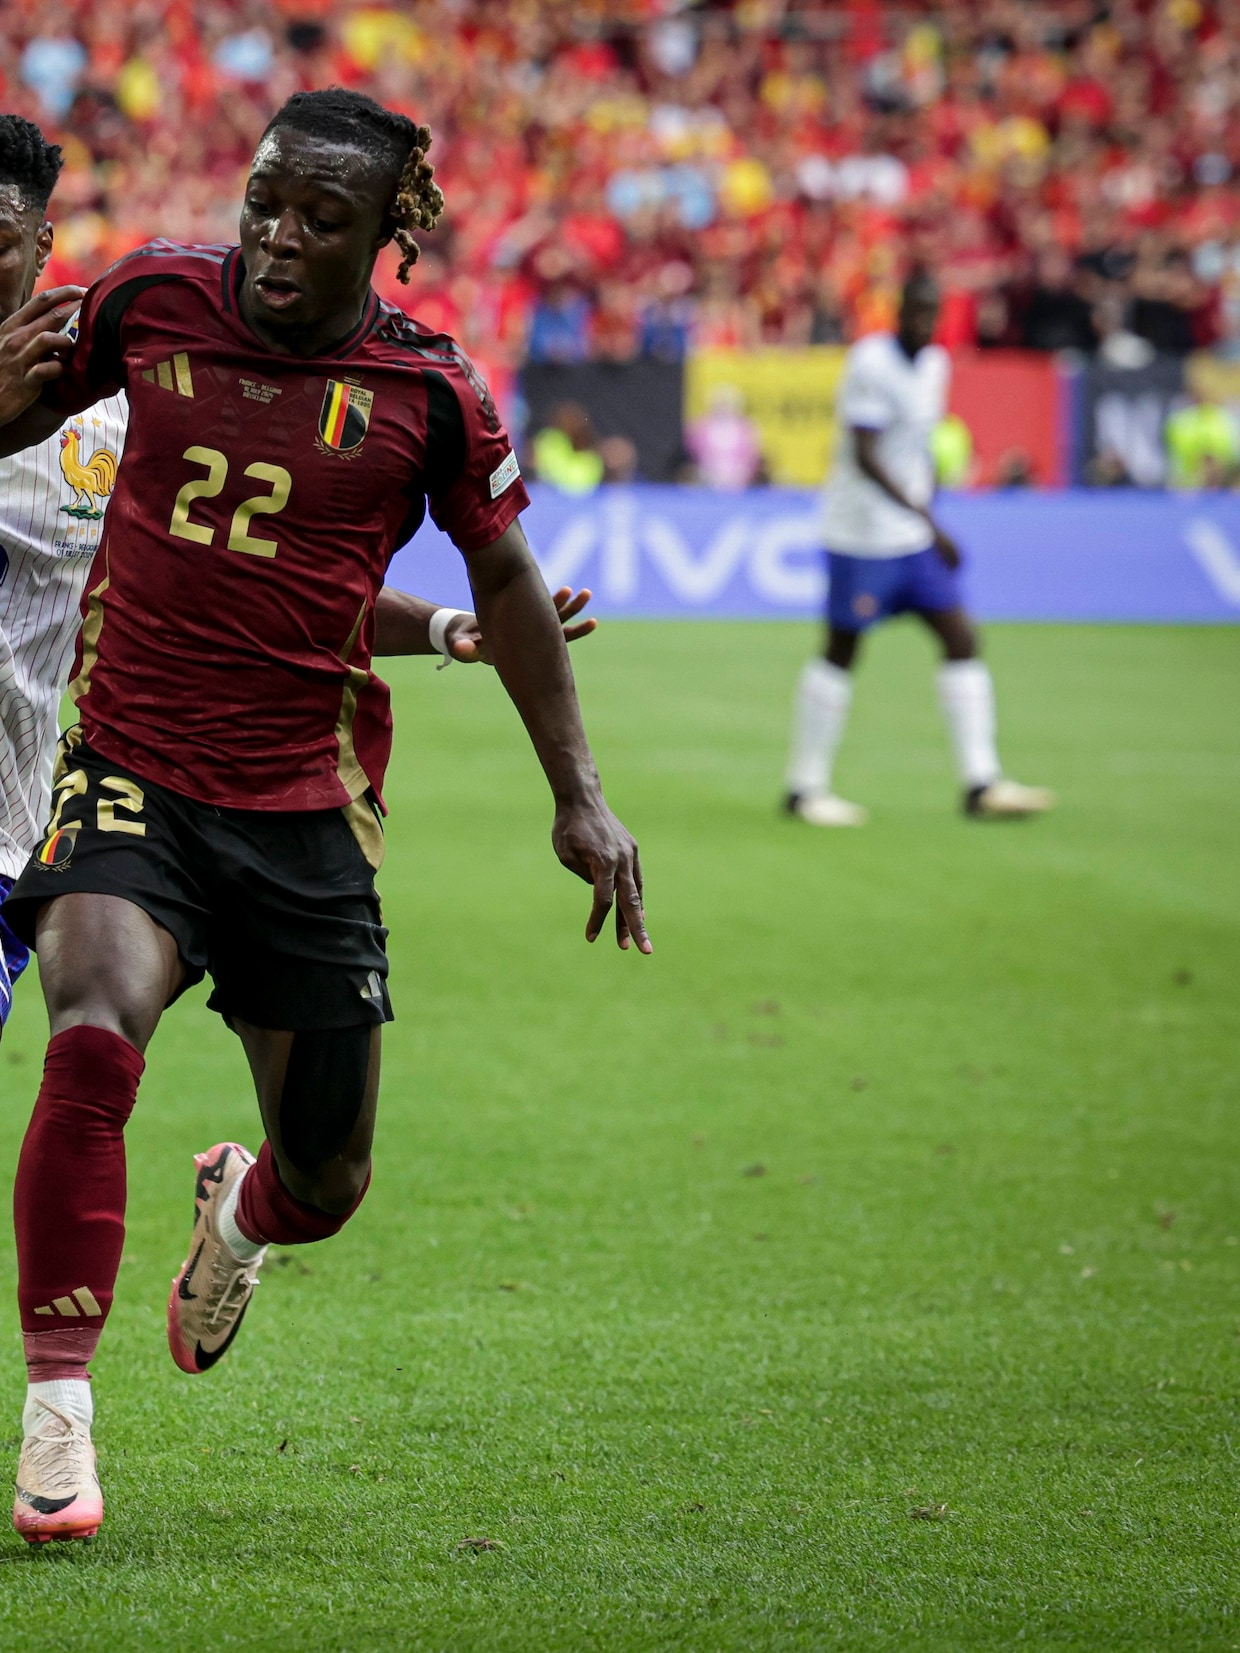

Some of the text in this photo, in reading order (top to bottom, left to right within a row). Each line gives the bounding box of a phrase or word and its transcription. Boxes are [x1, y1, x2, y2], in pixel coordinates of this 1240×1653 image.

[350, 388, 367, 397] ROYAL
[349, 393, 372, 403] BELGIAN
[169, 445, 292, 558] 22
[55, 540, 74, 550] FRANCE
[47, 769, 146, 837] 22
